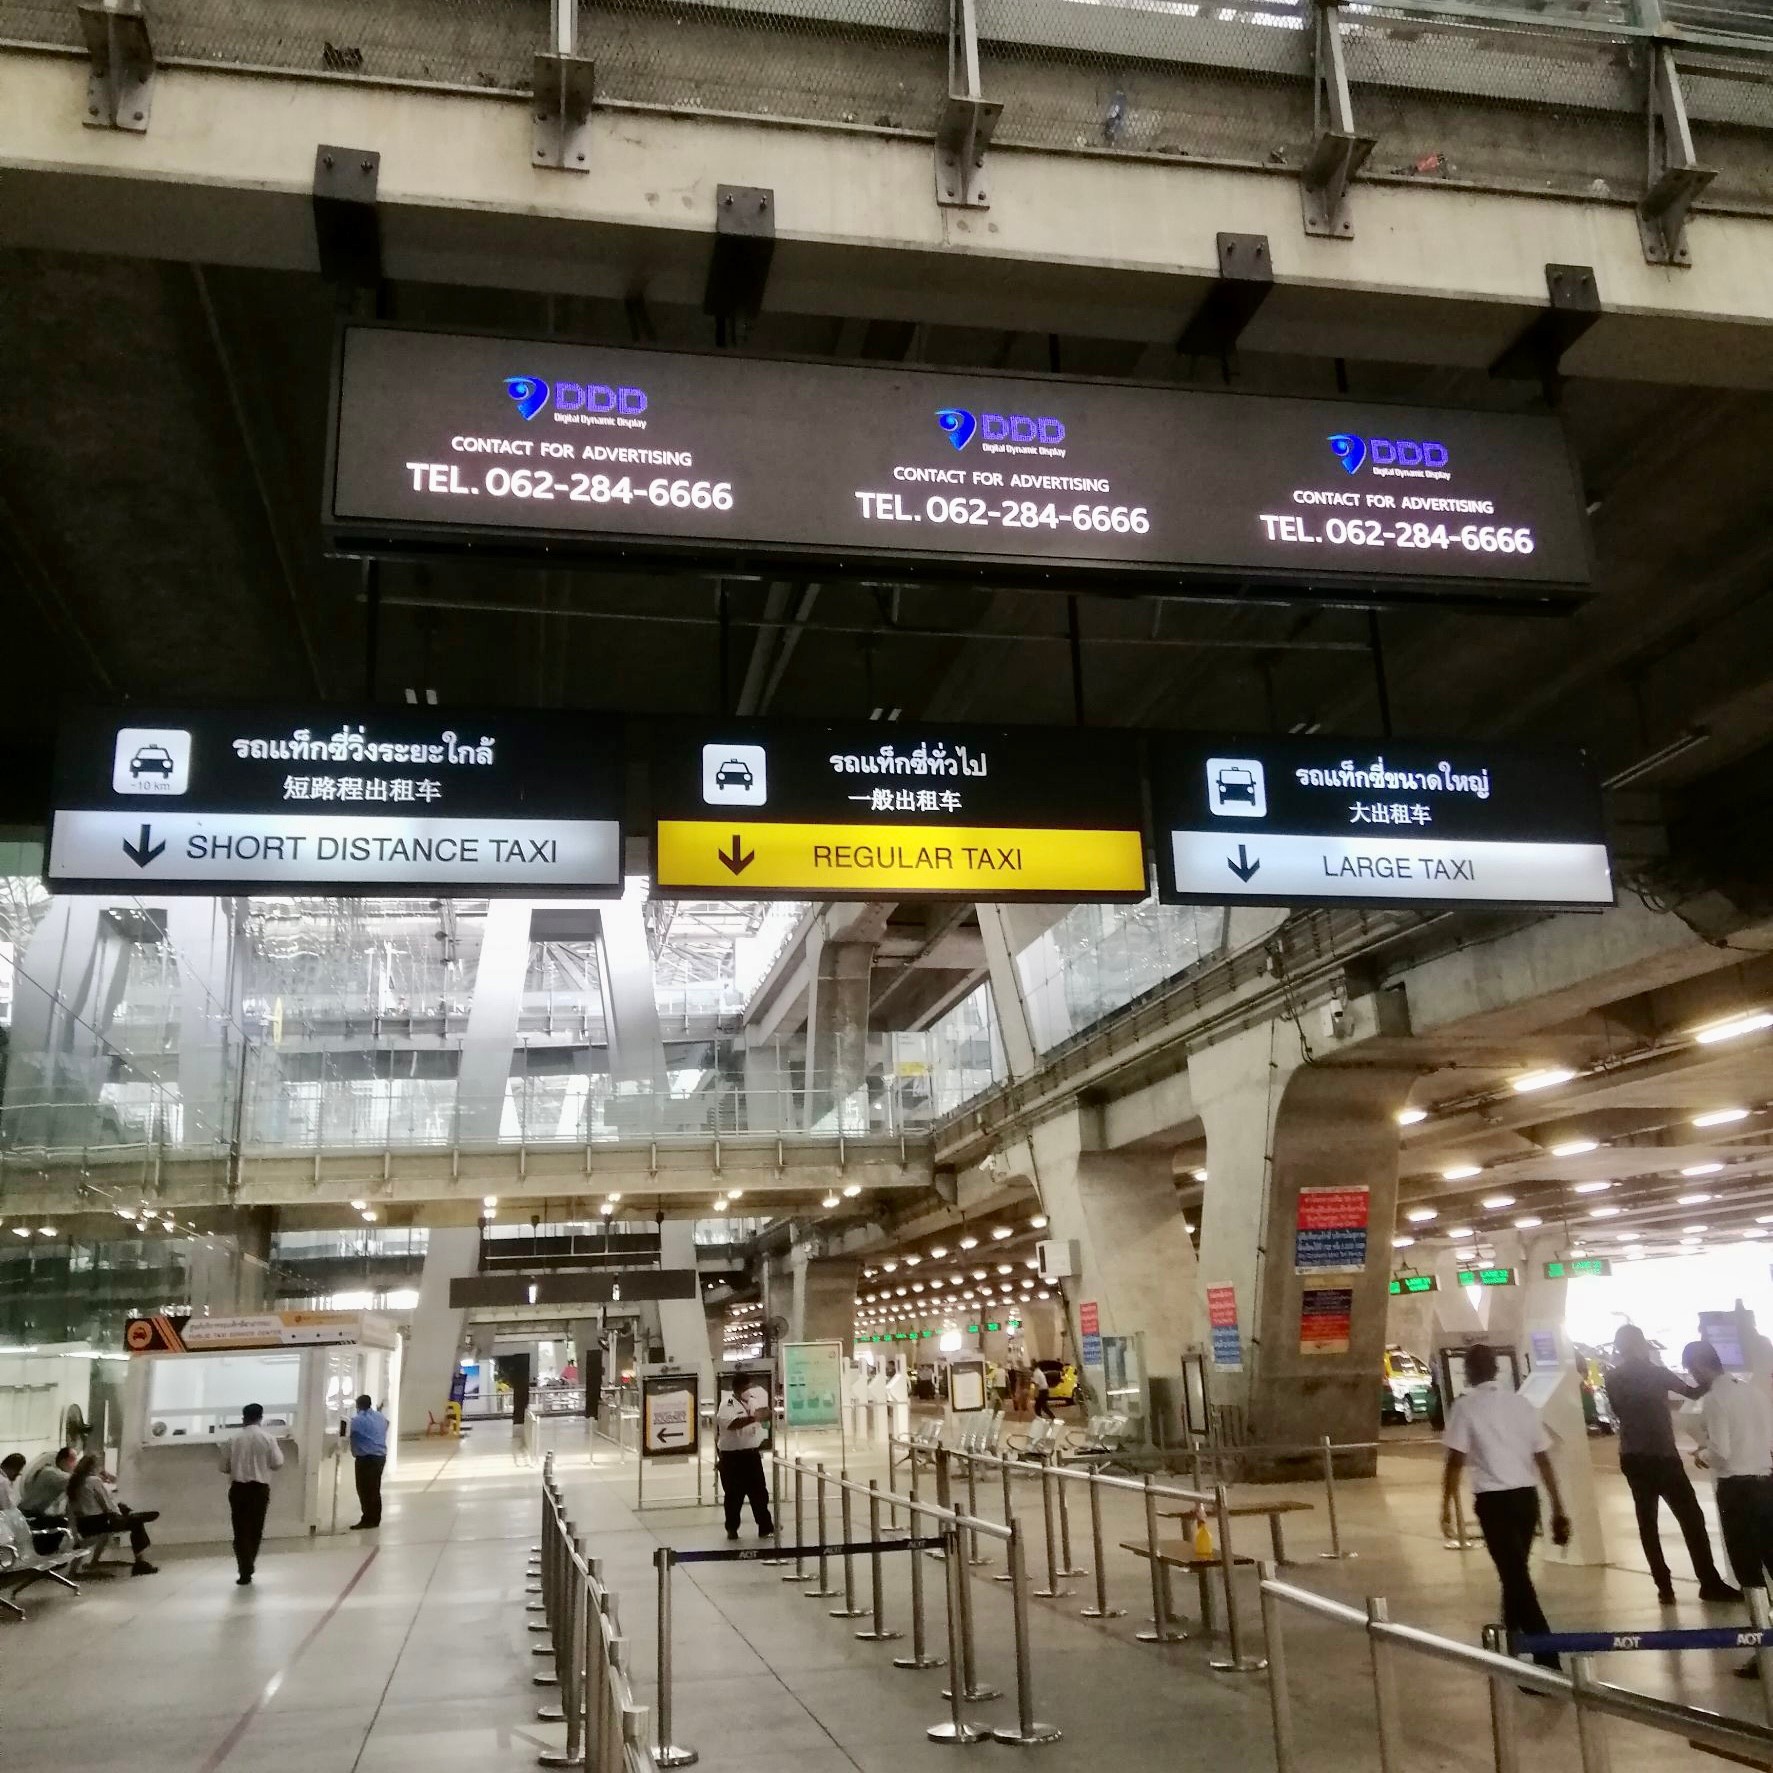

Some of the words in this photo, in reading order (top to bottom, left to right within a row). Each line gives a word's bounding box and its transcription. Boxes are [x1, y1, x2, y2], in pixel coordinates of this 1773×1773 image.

[554, 382, 648, 415] DDD
[554, 412, 579, 425] Digital
[580, 415, 615, 428] Dynamic
[617, 417, 647, 429] Display
[981, 413, 1066, 444] DDD
[451, 435, 534, 456] CONTACT
[541, 442, 575, 459] FOR
[582, 446, 692, 467] ADVERTISING
[982, 442, 1005, 453] Digital
[1005, 444, 1037, 456] Dynamic
[1038, 446, 1066, 458] Display
[1370, 439, 1449, 468] DDD
[405, 462, 479, 495] TEL.
[485, 467, 734, 510] 062-284-6666
[893, 466, 966, 484] CONTACT
[972, 471, 1004, 487] FOR
[1010, 474, 1109, 493] ADVERTISING
[1372, 466, 1394, 477] Digital
[1395, 468, 1424, 479] Dynamic
[1425, 470, 1451, 481] Display
[854, 491, 921, 522] TEL.
[926, 496, 1150, 535] 062-284-6666
[1293, 490, 1360, 507] CONTACT
[1366, 494, 1396, 508] FOR
[1401, 497, 1494, 514] ADVERTISING
[1259, 514, 1323, 543] TEL.
[1325, 518, 1534, 554] 062-284-6666
[232, 725, 496, 765] รถแท็กซี่วิ่งระยะใกล้
[829, 741, 988, 777] รถแท็กซี่ทั่วไป
[154, 781, 170, 791] km
[283, 775, 442, 803] 短路程出租车
[1295, 756, 1490, 799] รถแท็กซี่ขนาดใหญ่
[848, 787, 963, 813] 一般出租车
[1349, 801, 1432, 826] 大出租车
[186, 834, 307, 861] SHORT
[317, 837, 480, 863] DISTANCE
[488, 839, 557, 864] TAXI
[813, 845, 953, 871] REGULAR
[961, 847, 1023, 871] TAXI
[1323, 854, 1413, 880] LARGE
[1418, 858, 1476, 881] TAXI
[1613, 1636, 1641, 1650] AOT
[1736, 1632, 1764, 1646] AOT
